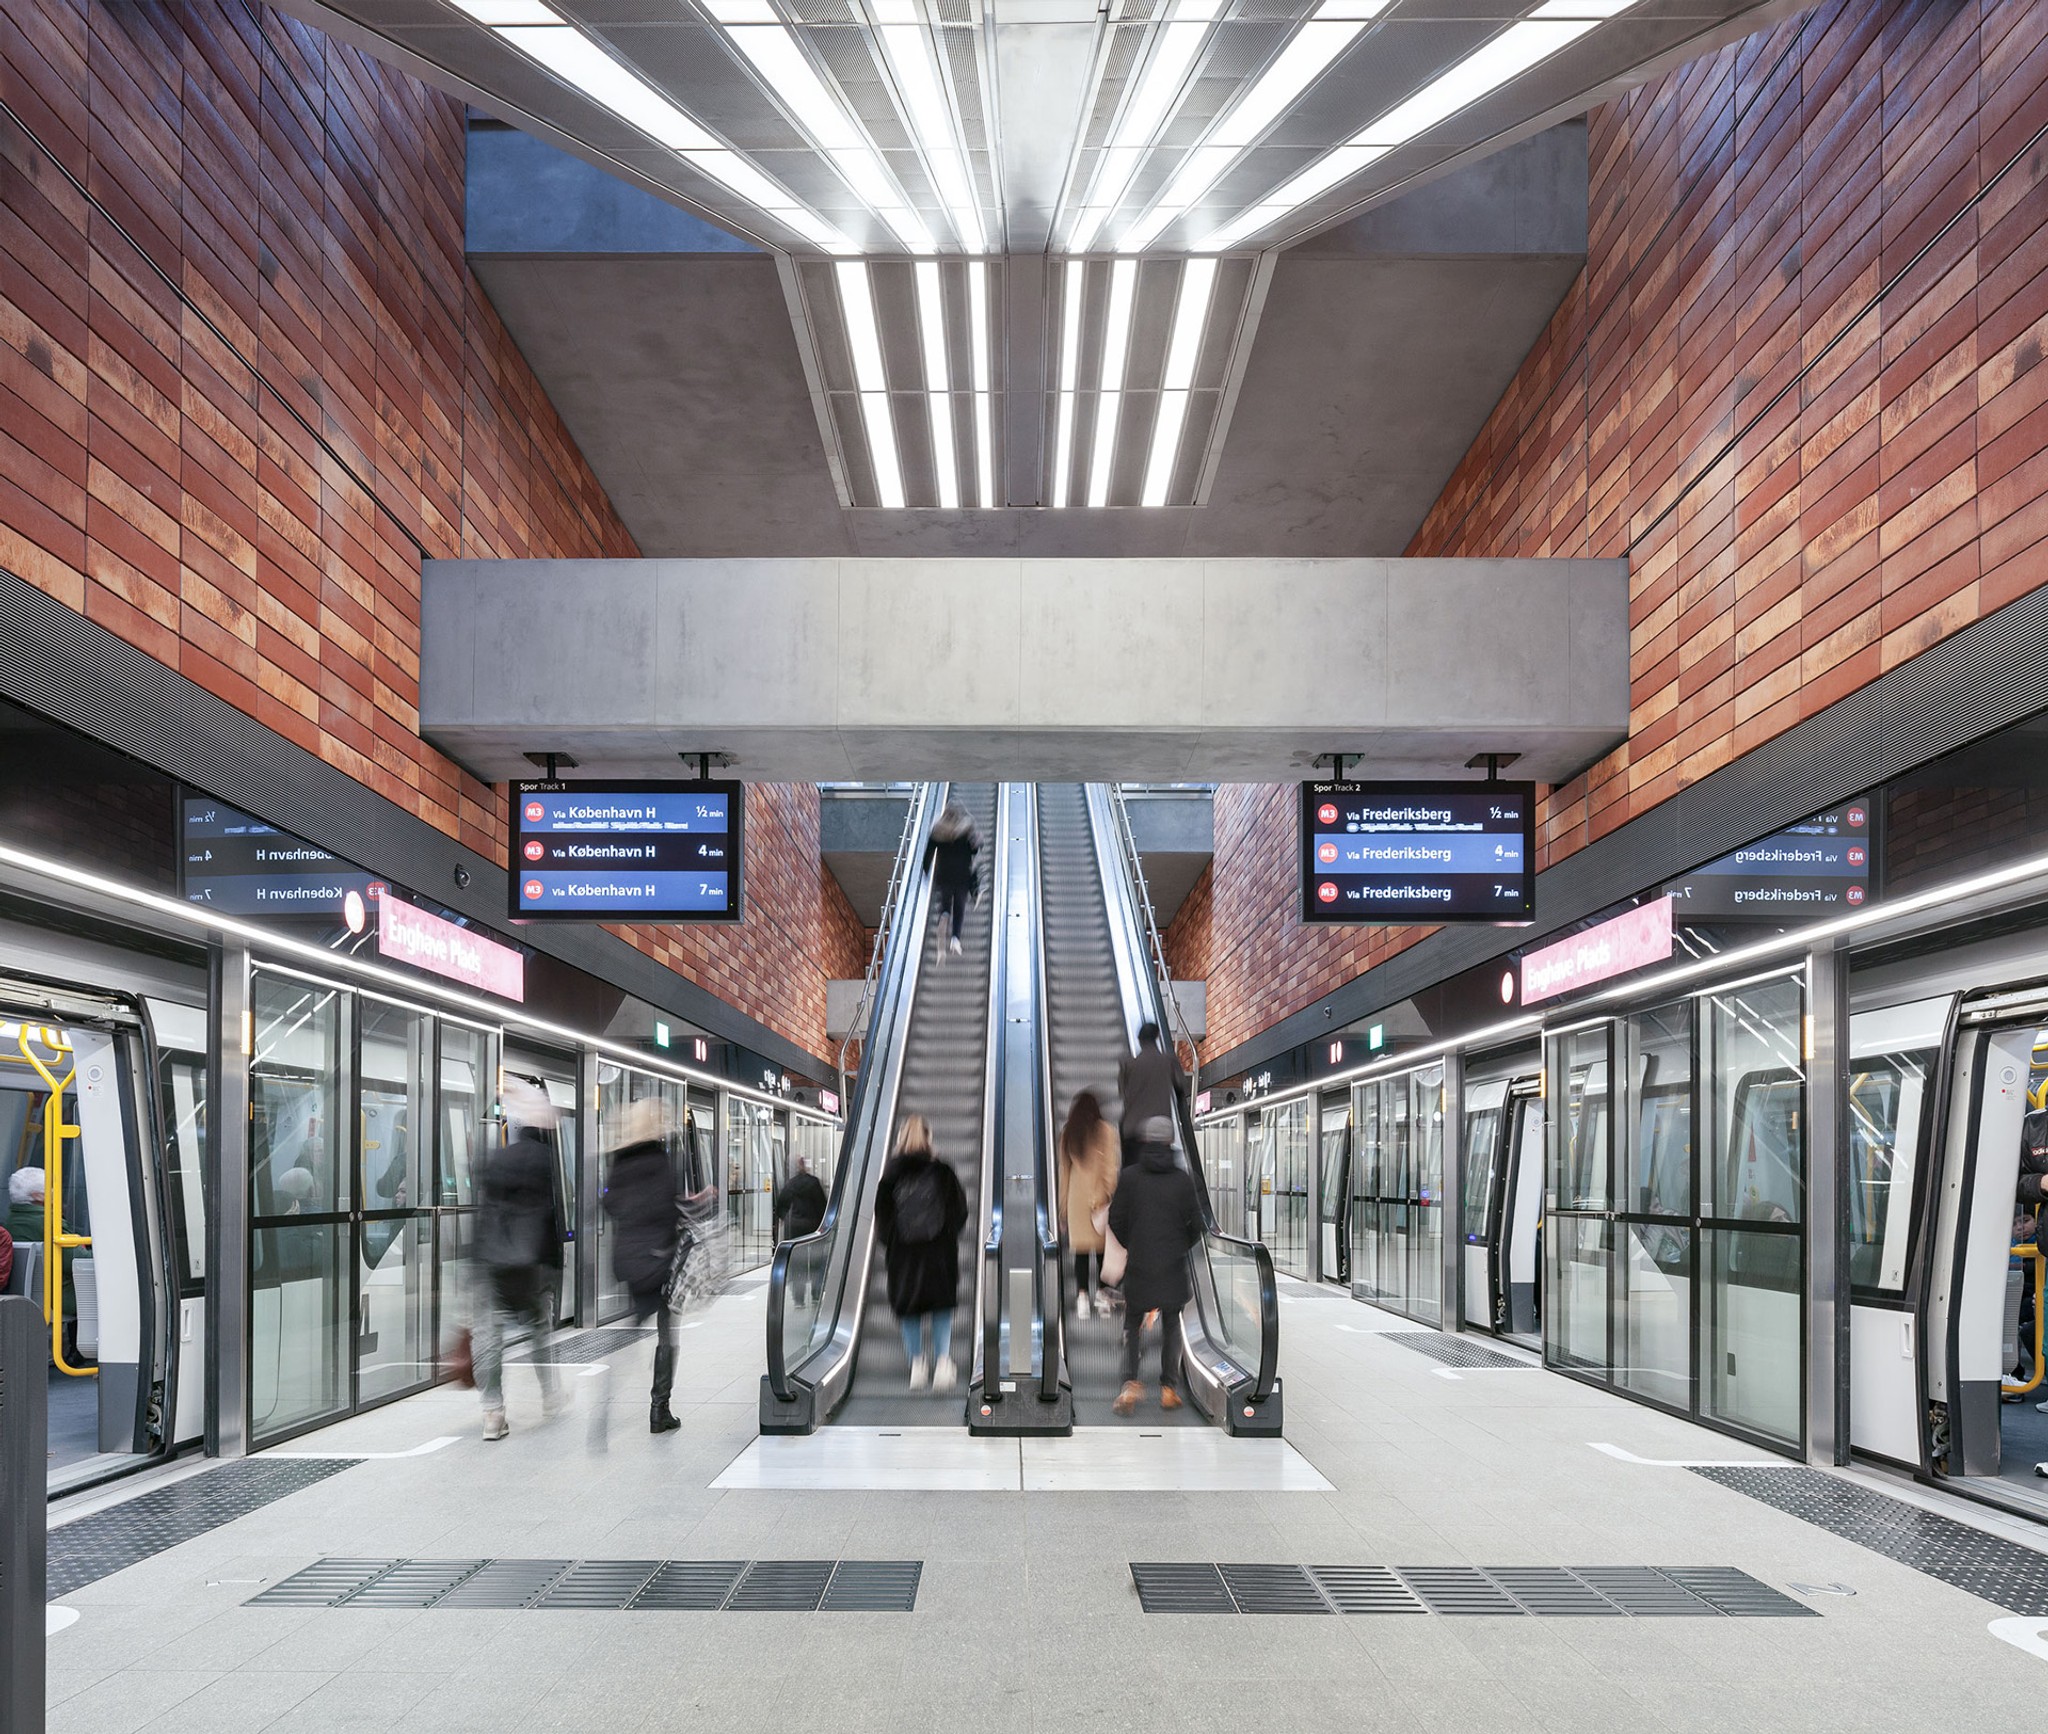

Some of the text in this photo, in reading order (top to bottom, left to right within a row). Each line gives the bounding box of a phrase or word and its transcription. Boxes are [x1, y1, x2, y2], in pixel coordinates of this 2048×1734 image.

[520, 783, 538, 791] Spor
[1314, 784, 1332, 792] Spor
[527, 808, 542, 816] M3
[569, 806, 642, 818] København
[647, 807, 655, 818] H
[1321, 810, 1336, 819] M3
[1363, 808, 1451, 824] Frederiksberg
[527, 847, 541, 855] M3
[569, 845, 642, 857] København
[646, 846, 655, 857] H
[699, 845, 707, 856] 4
[1321, 849, 1335, 857] M3
[1363, 847, 1451, 862] Frederiksberg
[1495, 845, 1503, 856] 4
[526, 886, 541, 894] M3
[569, 884, 641, 896] København
[646, 885, 655, 896] H
[700, 884, 707, 895] 7
[1321, 888, 1335, 896] M3
[1363, 886, 1451, 901] Frederiksberg
[1495, 885, 1502, 896] 7
[388, 915, 481, 974] Enghave Plads
[1528, 939, 1611, 992] Enghave Plads
